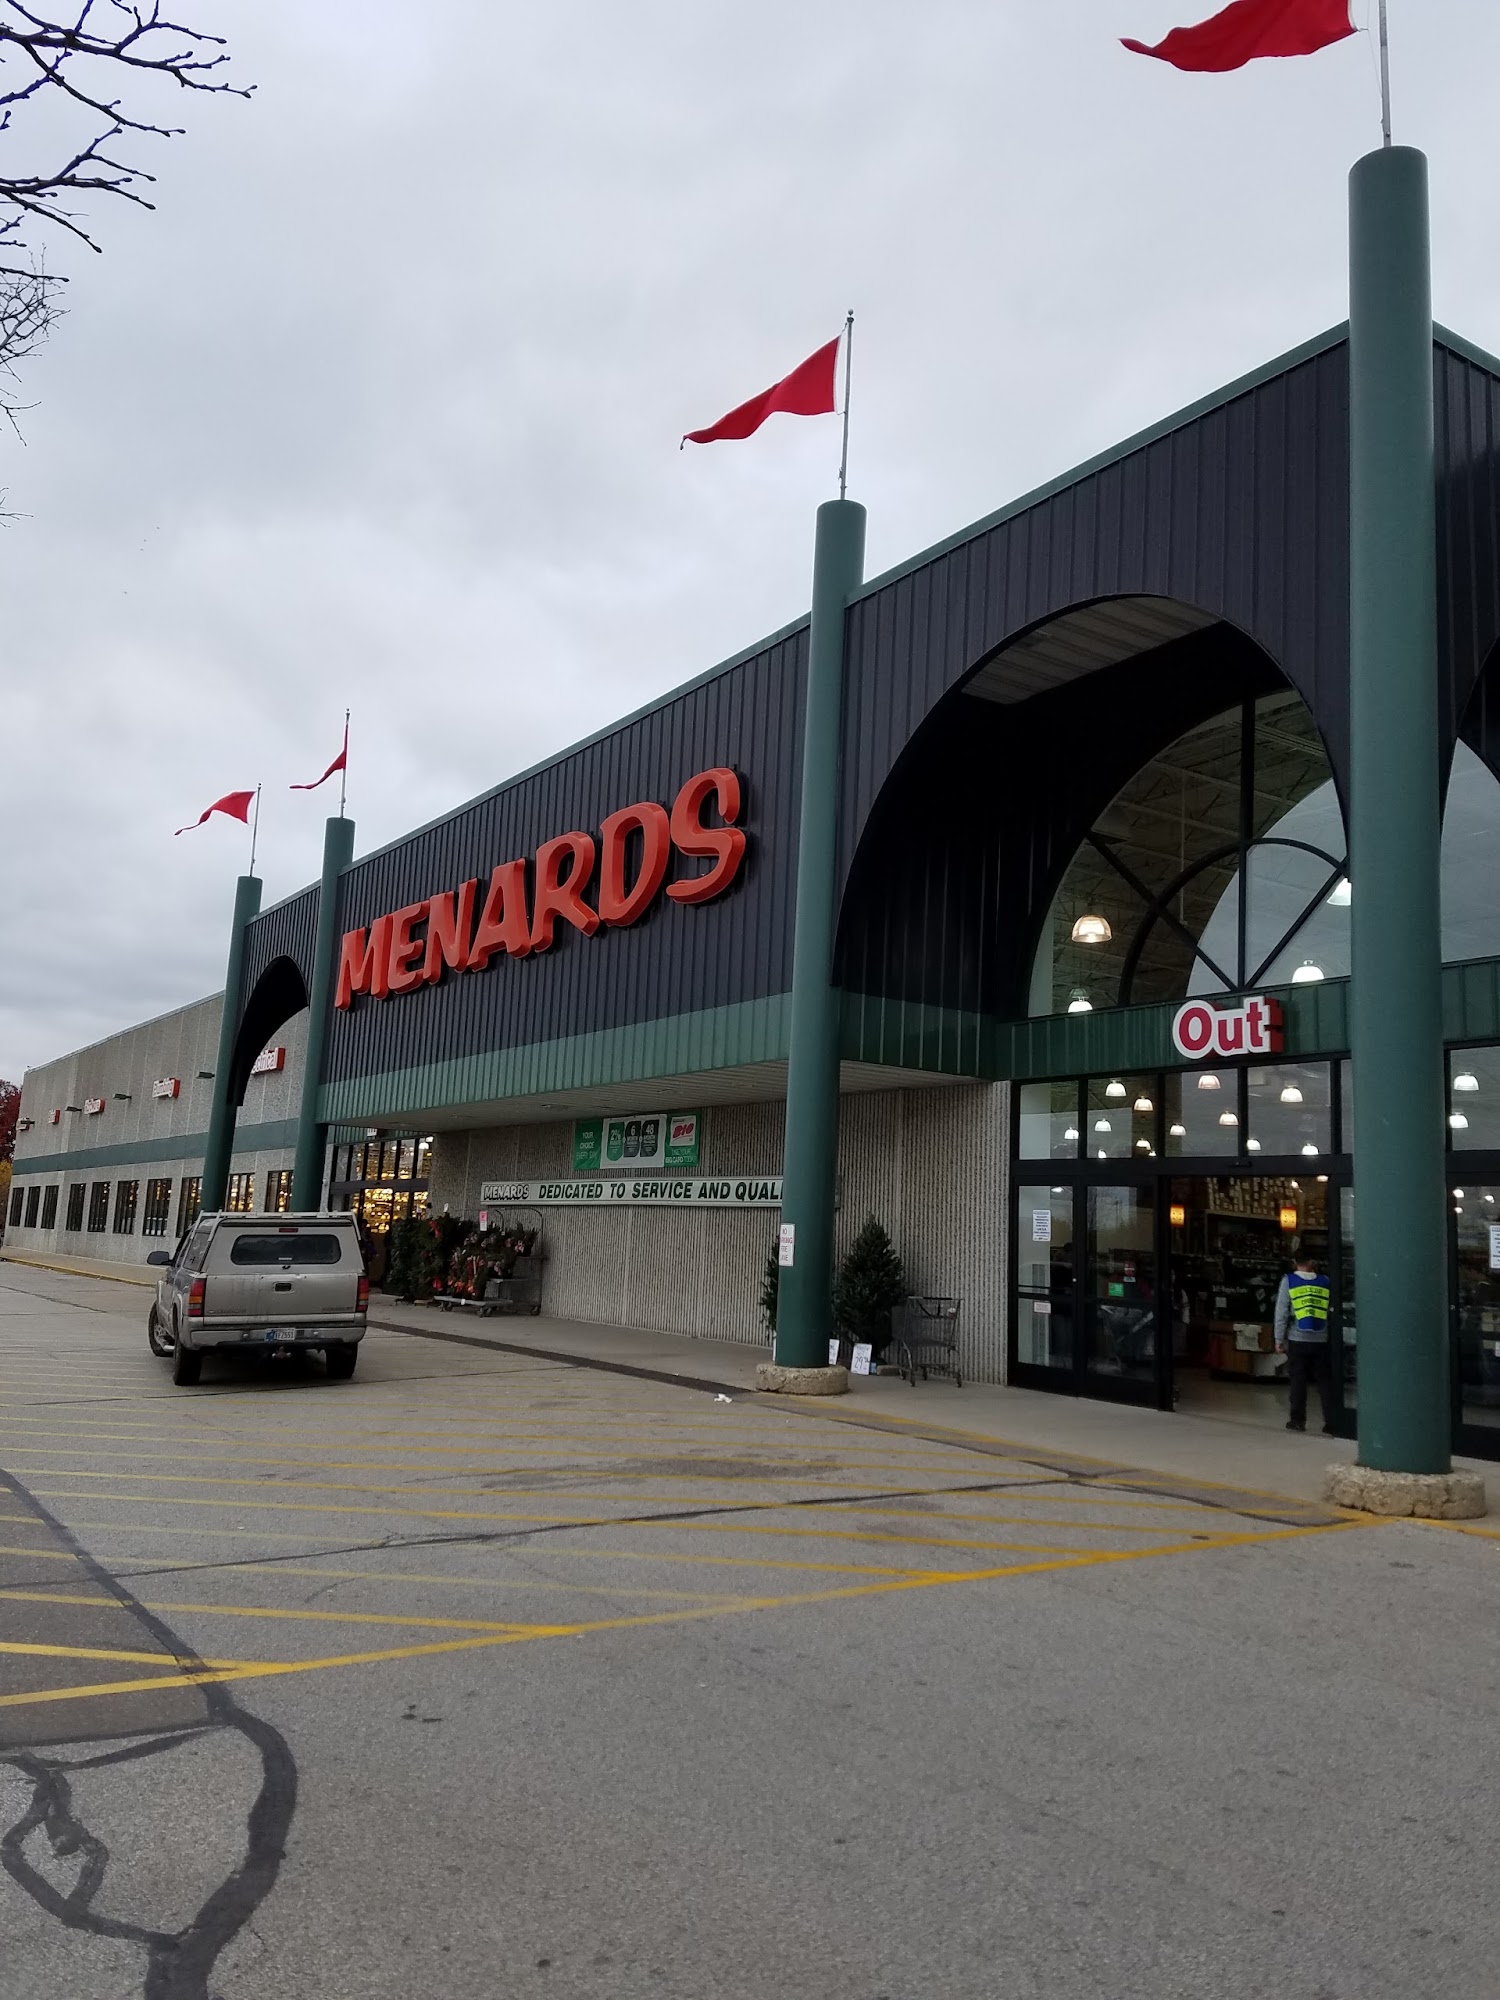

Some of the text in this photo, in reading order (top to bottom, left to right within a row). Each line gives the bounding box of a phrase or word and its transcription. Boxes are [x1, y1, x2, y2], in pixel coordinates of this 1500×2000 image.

[334, 767, 746, 1011] MENARDS
[1174, 998, 1268, 1057] Out
[611, 1129, 621, 1140] 2%
[630, 1125, 636, 1136] 6
[484, 1184, 529, 1200] MENARDS
[539, 1183, 603, 1199] DEDICATED
[610, 1183, 626, 1198] TO
[632, 1182, 693, 1199] SERVICE
[698, 1182, 731, 1199] AND
